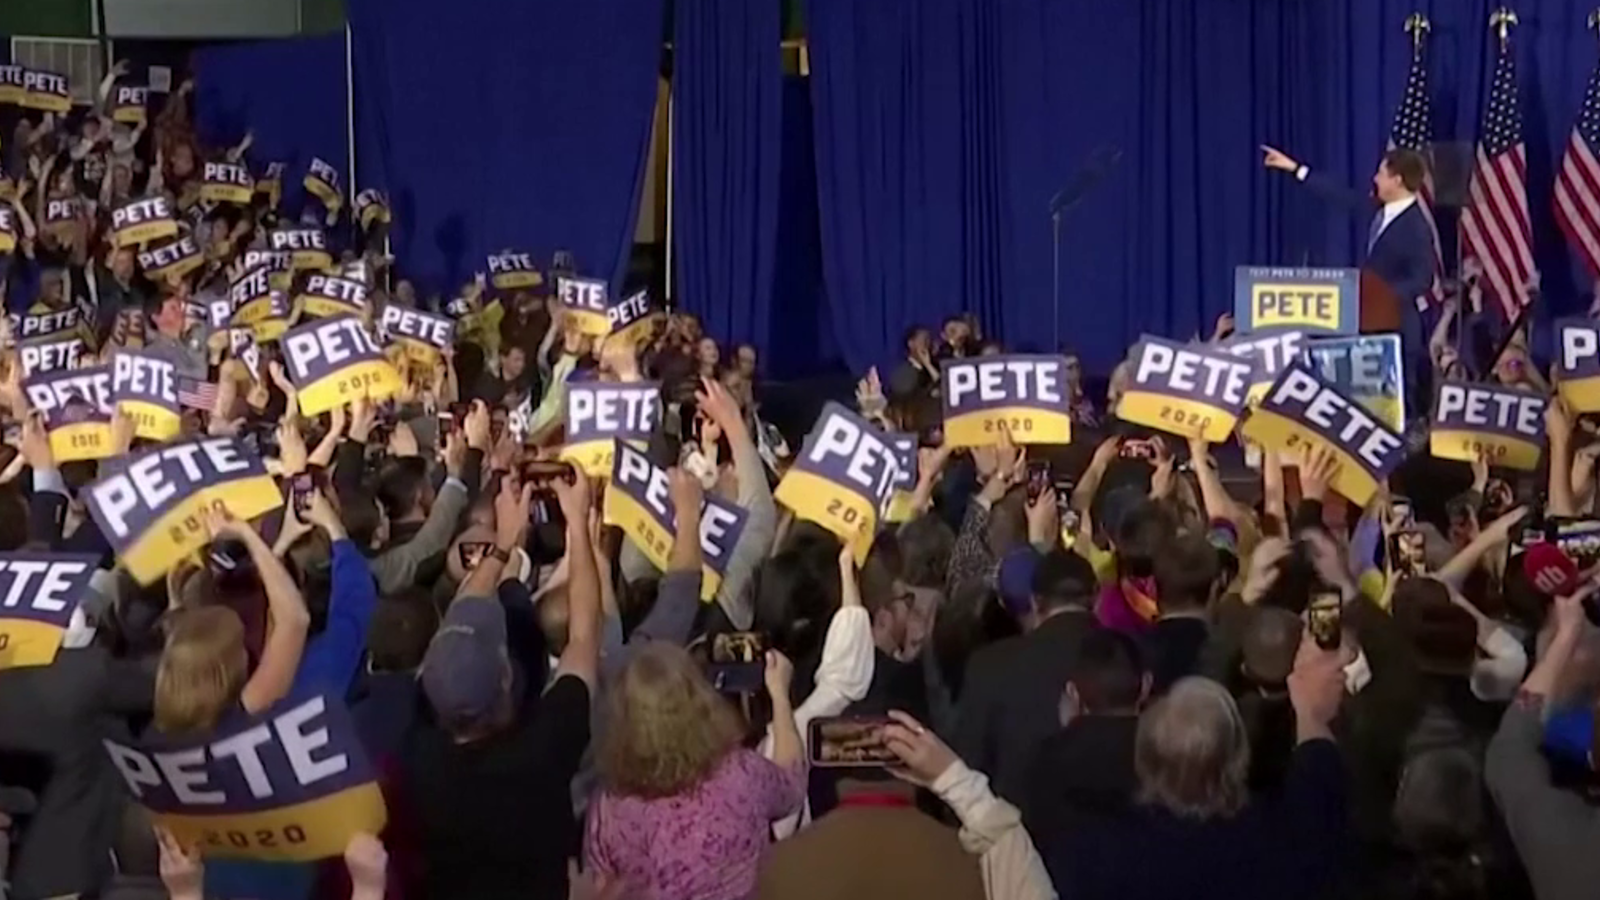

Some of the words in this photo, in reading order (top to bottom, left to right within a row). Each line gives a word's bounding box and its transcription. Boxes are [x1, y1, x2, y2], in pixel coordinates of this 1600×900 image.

[23, 71, 67, 95] PETE
[204, 162, 249, 186] PETE
[112, 196, 169, 228] PETE
[138, 236, 196, 270] PETE
[272, 229, 325, 250] PETE
[488, 252, 534, 273] PETE
[306, 275, 367, 306] PETE
[1258, 291, 1333, 319] PETE
[22, 306, 79, 336] PETE
[607, 288, 649, 328] PETE
[382, 305, 450, 346] PETE
[113, 353, 176, 401] PETE
[949, 361, 1061, 407] PETE
[1136, 342, 1250, 403] PETE
[569, 387, 658, 434] PETE
[984, 418, 1033, 433] 2020
[1160, 406, 1211, 429] 2020
[1272, 368, 1400, 468] PETE
[1437, 385, 1544, 435] PETE
[809, 413, 899, 497] PET
[92, 438, 249, 538] PETE
[102, 695, 348, 804] PETE
[207, 824, 307, 849] 2020
